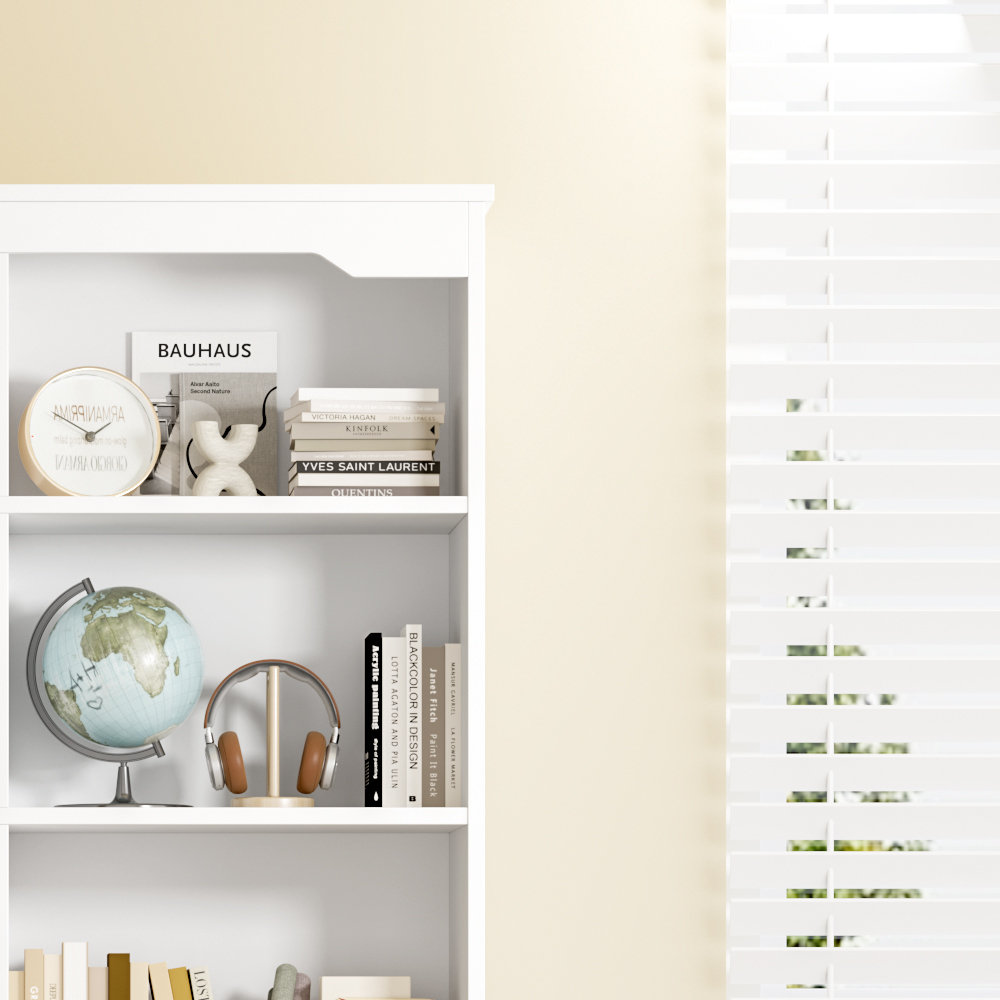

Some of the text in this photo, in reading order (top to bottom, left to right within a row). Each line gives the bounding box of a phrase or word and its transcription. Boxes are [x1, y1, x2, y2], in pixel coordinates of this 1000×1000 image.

[158, 343, 252, 358] BAUHAUS
[311, 413, 347, 421] VICTORIA
[302, 462, 436, 472] YVES SAINT LAURENT
[331, 488, 393, 496] QUENTINS
[371, 645, 380, 730] Acrylic painting
[429, 668, 437, 694] Janet
[409, 633, 418, 769] BLACKCOLOR IN DESIGN
[429, 699, 437, 723] Fitch
[429, 734, 437, 758] Paint
[429, 773, 437, 797] Black
